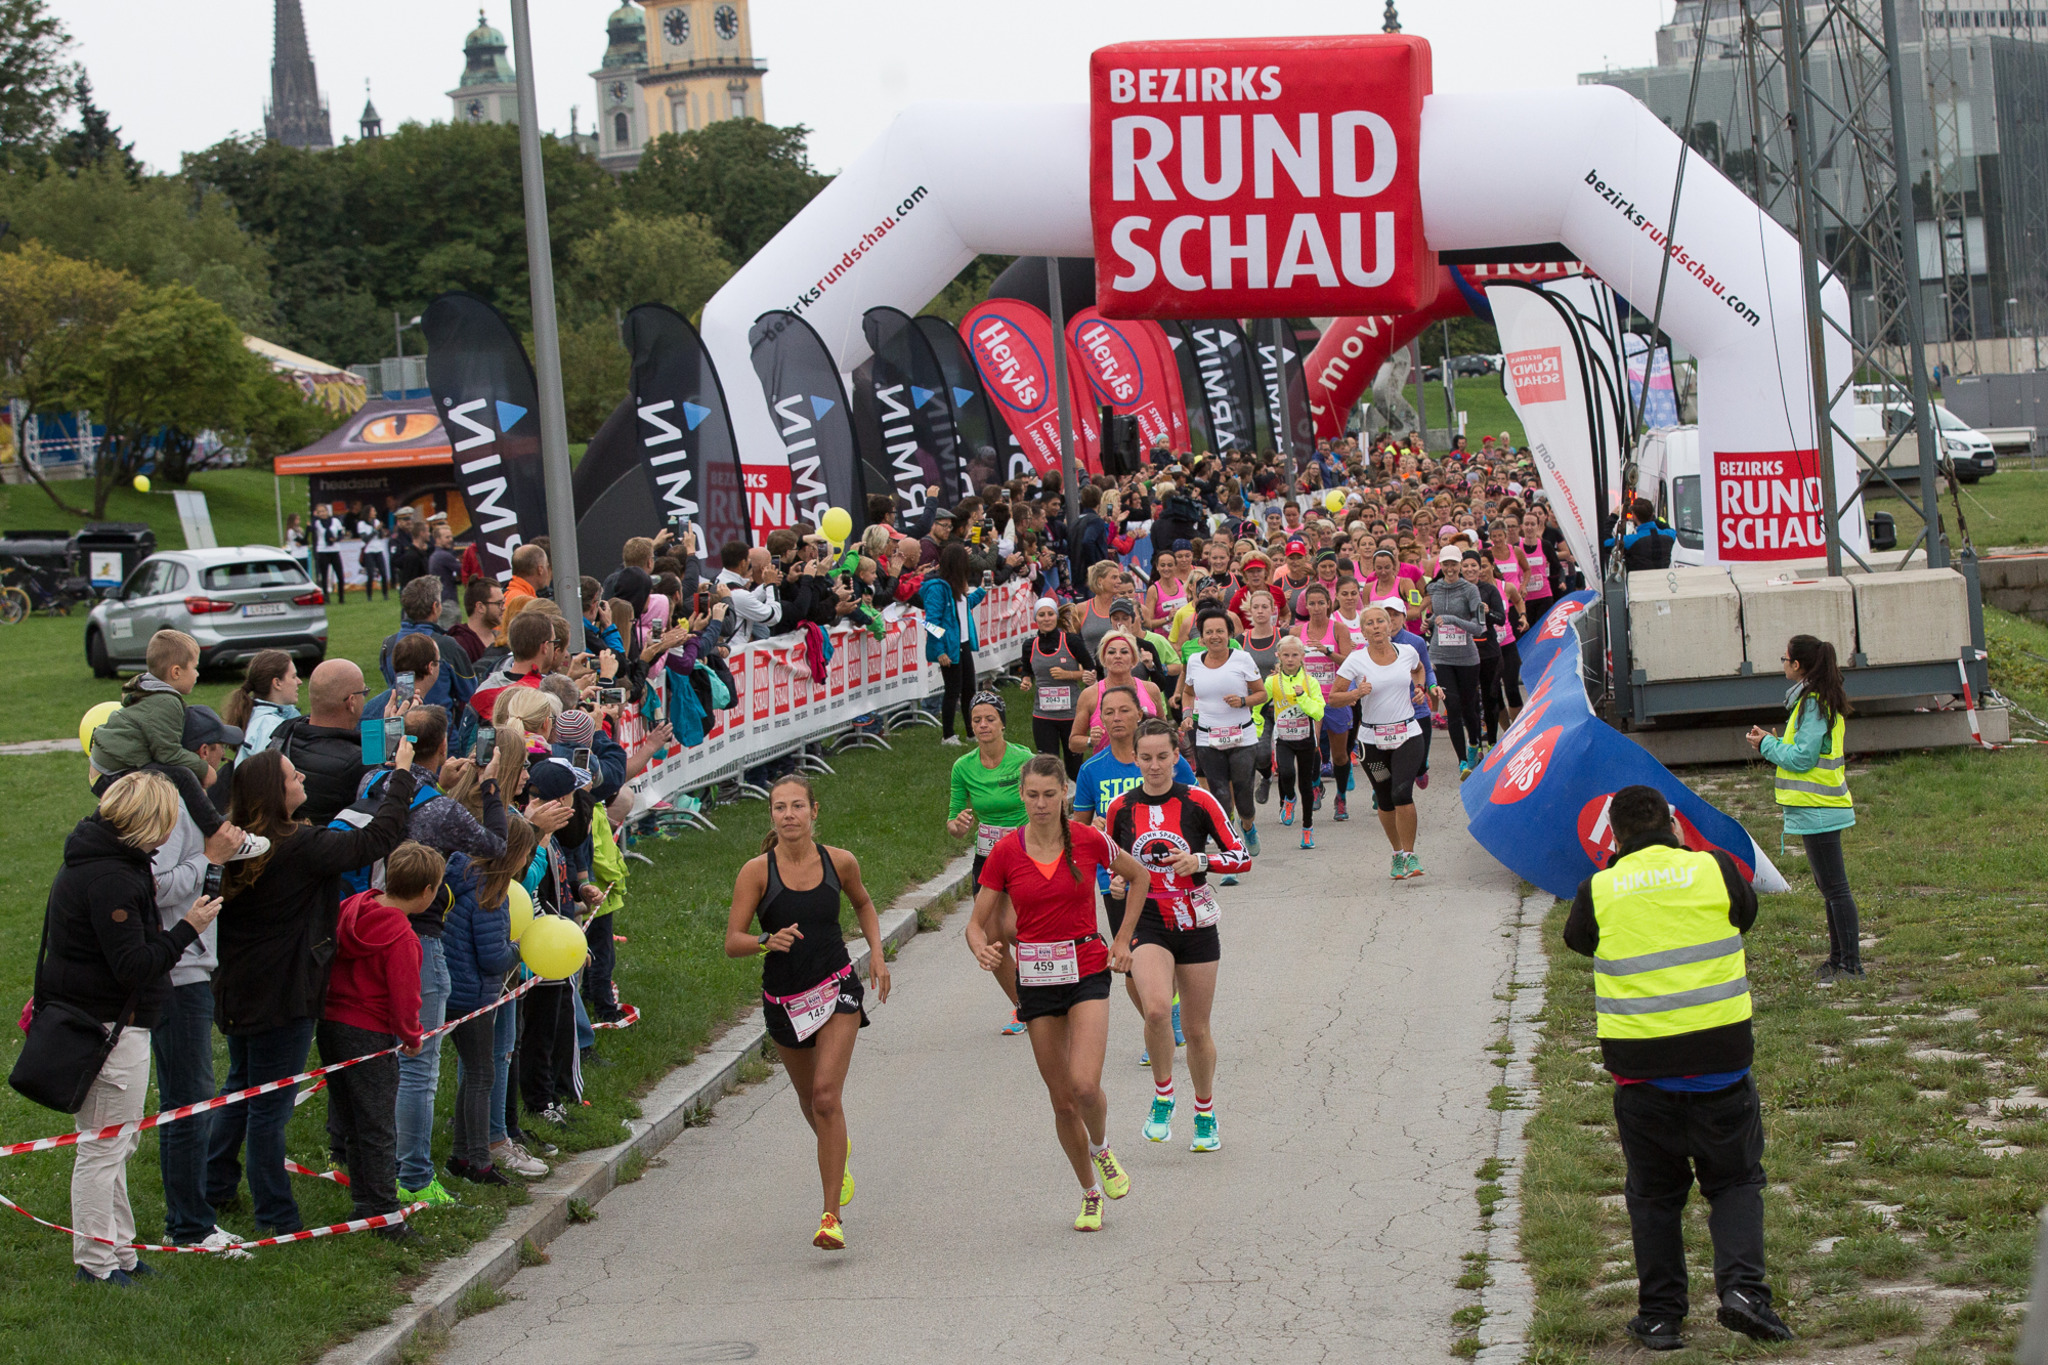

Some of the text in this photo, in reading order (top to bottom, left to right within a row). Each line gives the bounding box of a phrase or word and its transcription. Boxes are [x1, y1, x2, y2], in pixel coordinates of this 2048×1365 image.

[1109, 66, 1283, 104] BEZIRKS
[1111, 110, 1399, 202] RUND
[1111, 211, 1396, 294] SCHAU
[1584, 168, 1761, 328] bezirksrundschau.com
[979, 320, 1038, 406] Hervis
[1082, 325, 1134, 400] Hervis
[1137, 414, 1157, 446] ONLINE
[1149, 407, 1168, 434] STORE
[1030, 429, 1056, 465] MOBILE
[320, 476, 389, 491] headstart
[1720, 460, 1784, 476] BEZIRKS
[1721, 476, 1824, 515] RUND
[1721, 516, 1826, 549] SCHAU
[1160, 831, 1189, 851] SPARTANS
[1613, 866, 1699, 892] HIKIMUS
[1033, 961, 1054, 971] 459
[808, 1005, 825, 1020] 145
